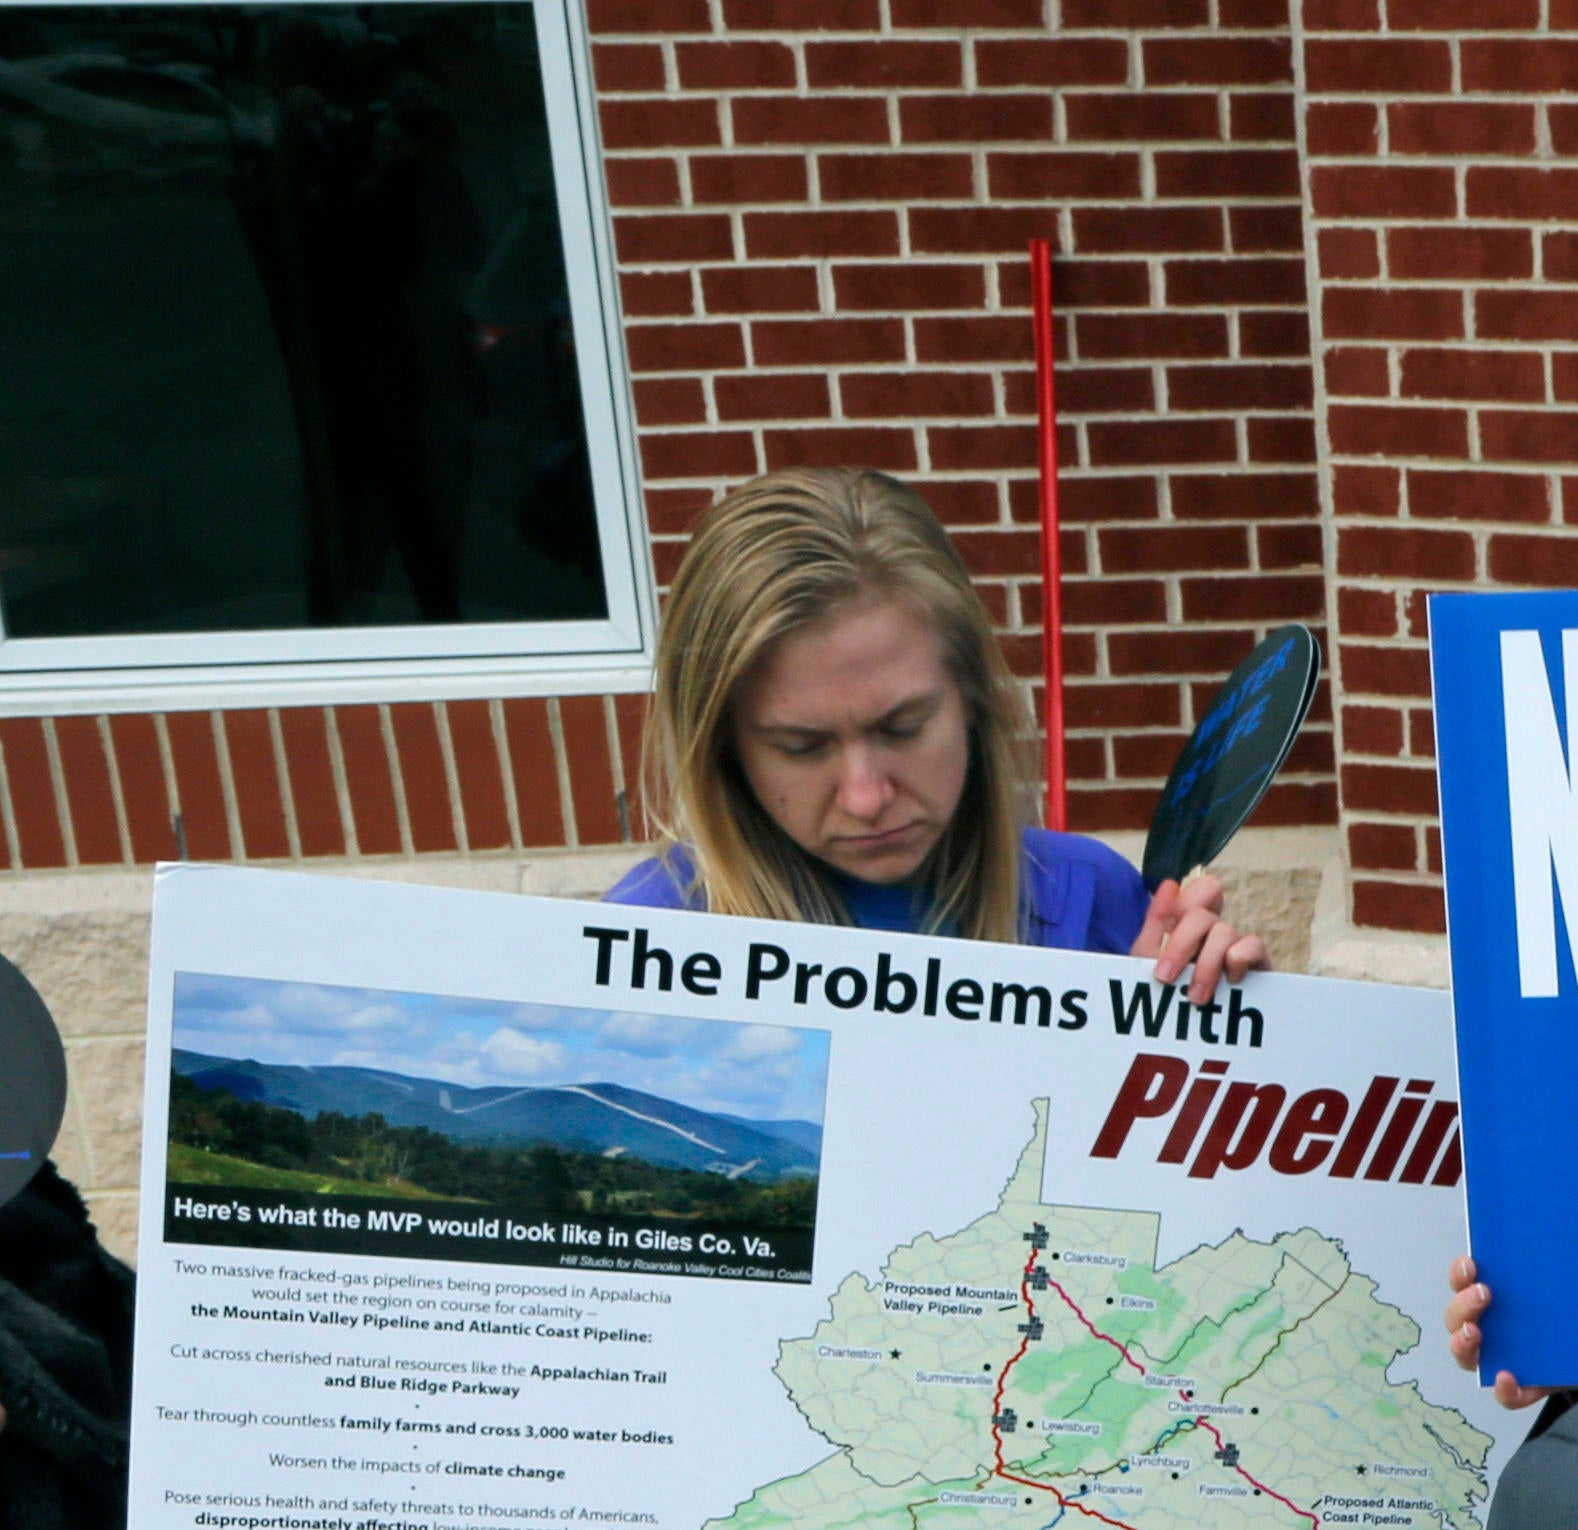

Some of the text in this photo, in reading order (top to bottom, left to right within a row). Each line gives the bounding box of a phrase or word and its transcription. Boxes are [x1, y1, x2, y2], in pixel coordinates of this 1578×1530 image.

[583, 926, 1265, 1048] The Problems With
[1090, 1052, 1462, 1187] Pipelin
[174, 1196, 776, 1258] Here’s what the MVP would look like in Giles Co. Va.
[1062, 1251, 1126, 1268] Clarksburg
[173, 1259, 672, 1305] Two massive fracked-gas pipelines being proposed in Appalachia
[884, 1282, 1018, 1302] Proposed Mountain
[251, 1287, 584, 1322] would set the region on course for calamity
[884, 1299, 984, 1317] Valley Pipeline
[190, 1303, 653, 1344] the Mountain Valley Pipeline and Atlantic Coast Pipeline:
[818, 1346, 882, 1360] Charleston
[169, 1343, 668, 1385] Cut across cherished natural resources like the Appalachian Trail
[323, 1374, 521, 1400] and Blue Ridge Parkway
[1144, 1375, 1195, 1389] Staunton
[1167, 1401, 1245, 1416] Charlottesville
[156, 1405, 675, 1445] Tear through countless family farms and cross 3,000 water bodies
[1041, 1419, 1101, 1435] Lewisburg
[268, 1453, 566, 1483] Worsen the impacts of climate change
[1131, 1455, 1190, 1471] Lynchburg
[1373, 1464, 1429, 1477] Richmond
[1092, 1484, 1144, 1496] Roanoke
[1199, 1486, 1248, 1498] Farmville
[1324, 1495, 1434, 1511] Proposed Atlantic
[1322, 1511, 1413, 1527] Coast Pipeline
